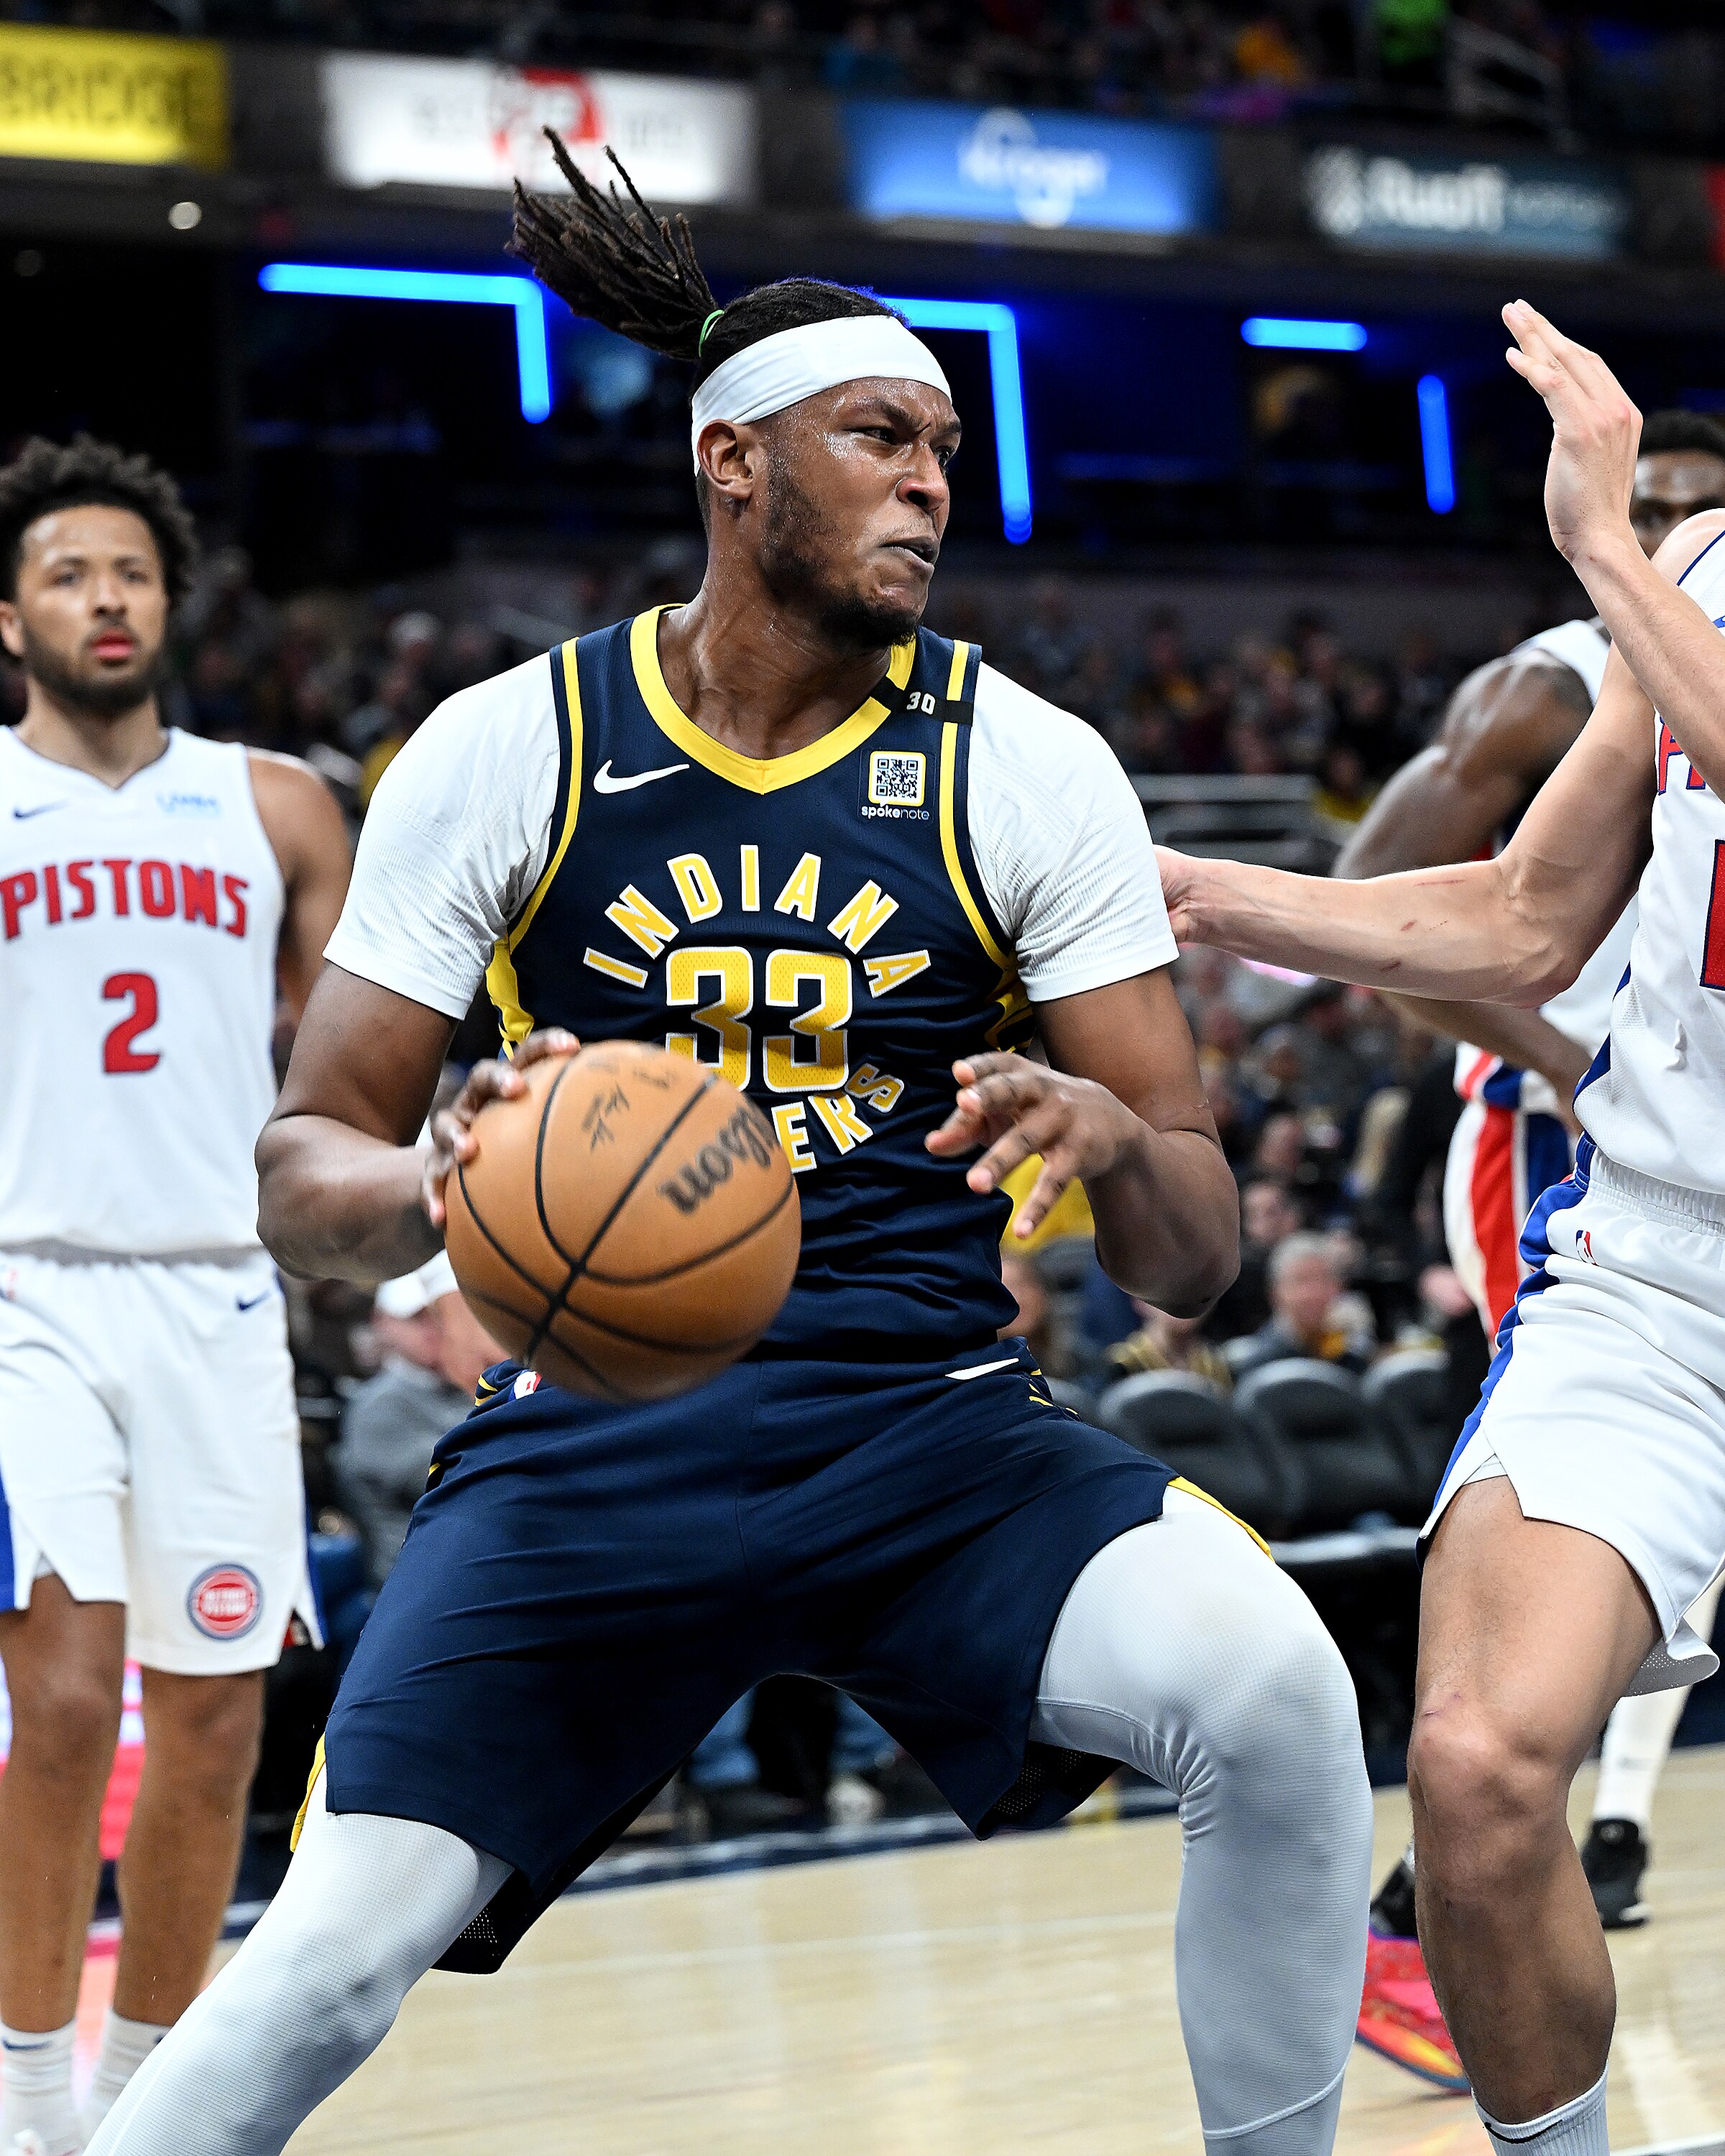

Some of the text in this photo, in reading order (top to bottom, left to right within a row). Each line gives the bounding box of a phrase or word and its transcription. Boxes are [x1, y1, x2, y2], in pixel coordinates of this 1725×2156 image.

[906, 691, 936, 715] 30
[861, 804, 930, 820] spokenote
[0, 859, 249, 940] PISTONS
[583, 844, 932, 998] INDIANA
[102, 971, 161, 1074] 2
[665, 945, 853, 1093] 33
[771, 1062, 905, 1174] ERS
